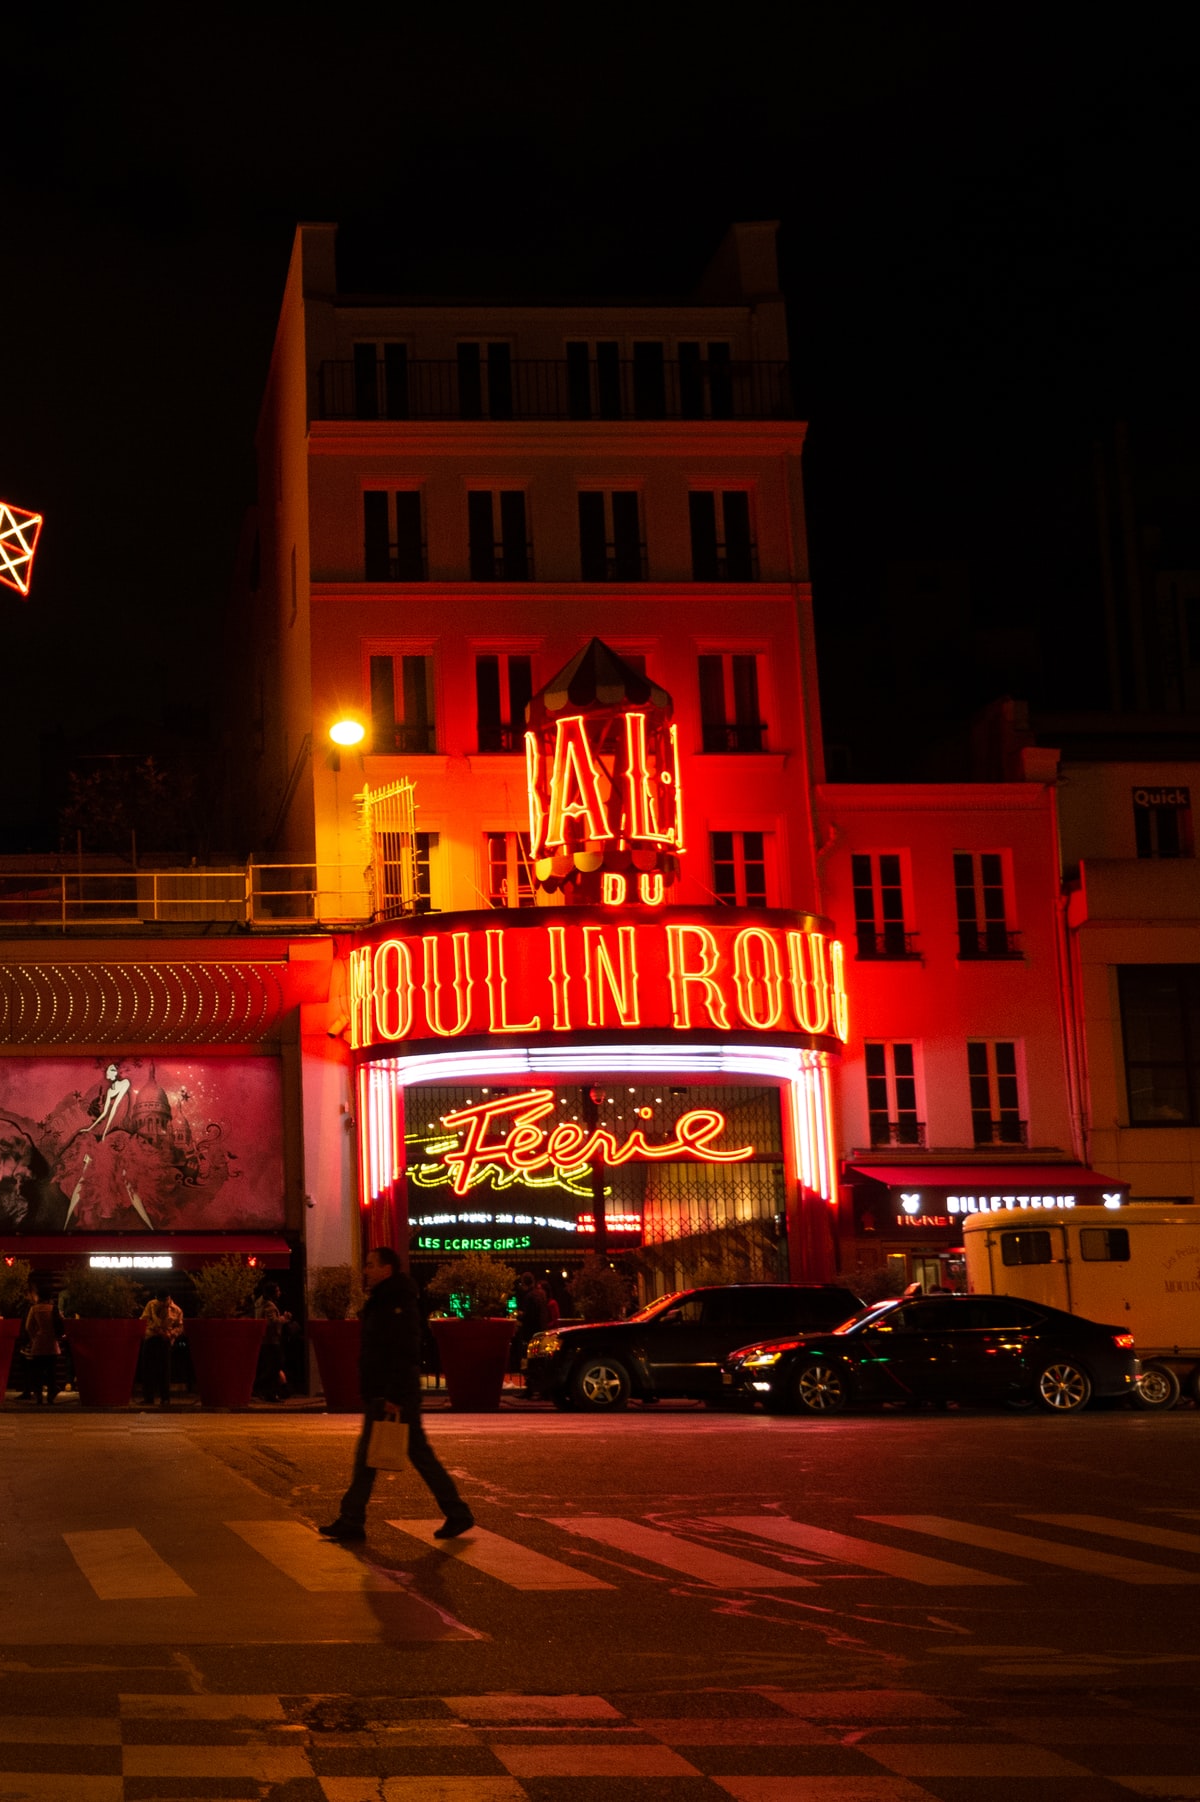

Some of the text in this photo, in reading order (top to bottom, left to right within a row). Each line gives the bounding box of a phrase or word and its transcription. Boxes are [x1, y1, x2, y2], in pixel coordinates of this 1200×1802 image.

[1134, 789, 1187, 807] Quick
[603, 872, 664, 905] DU
[350, 926, 639, 1049] MOULIN
[443, 1089, 754, 1195] Féerie
[418, 1236, 441, 1249] LES
